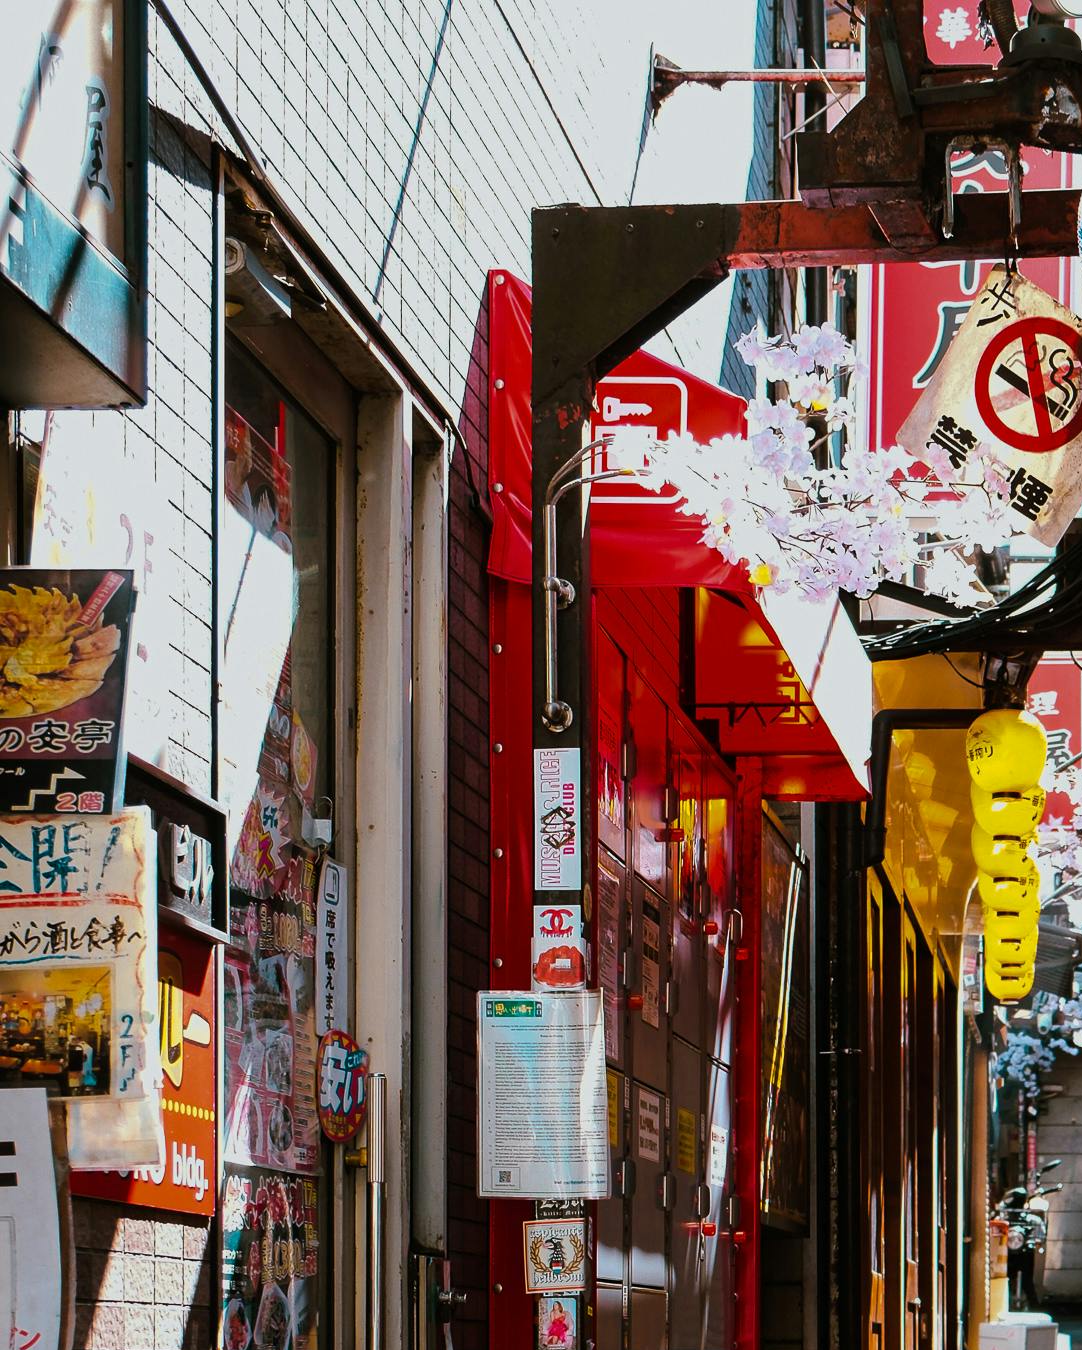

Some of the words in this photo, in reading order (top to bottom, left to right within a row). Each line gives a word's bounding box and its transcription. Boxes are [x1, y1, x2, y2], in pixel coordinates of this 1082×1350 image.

[56, 791, 104, 812] 2階
[320, 1041, 364, 1114] 安い
[172, 1141, 209, 1200] bldg.
